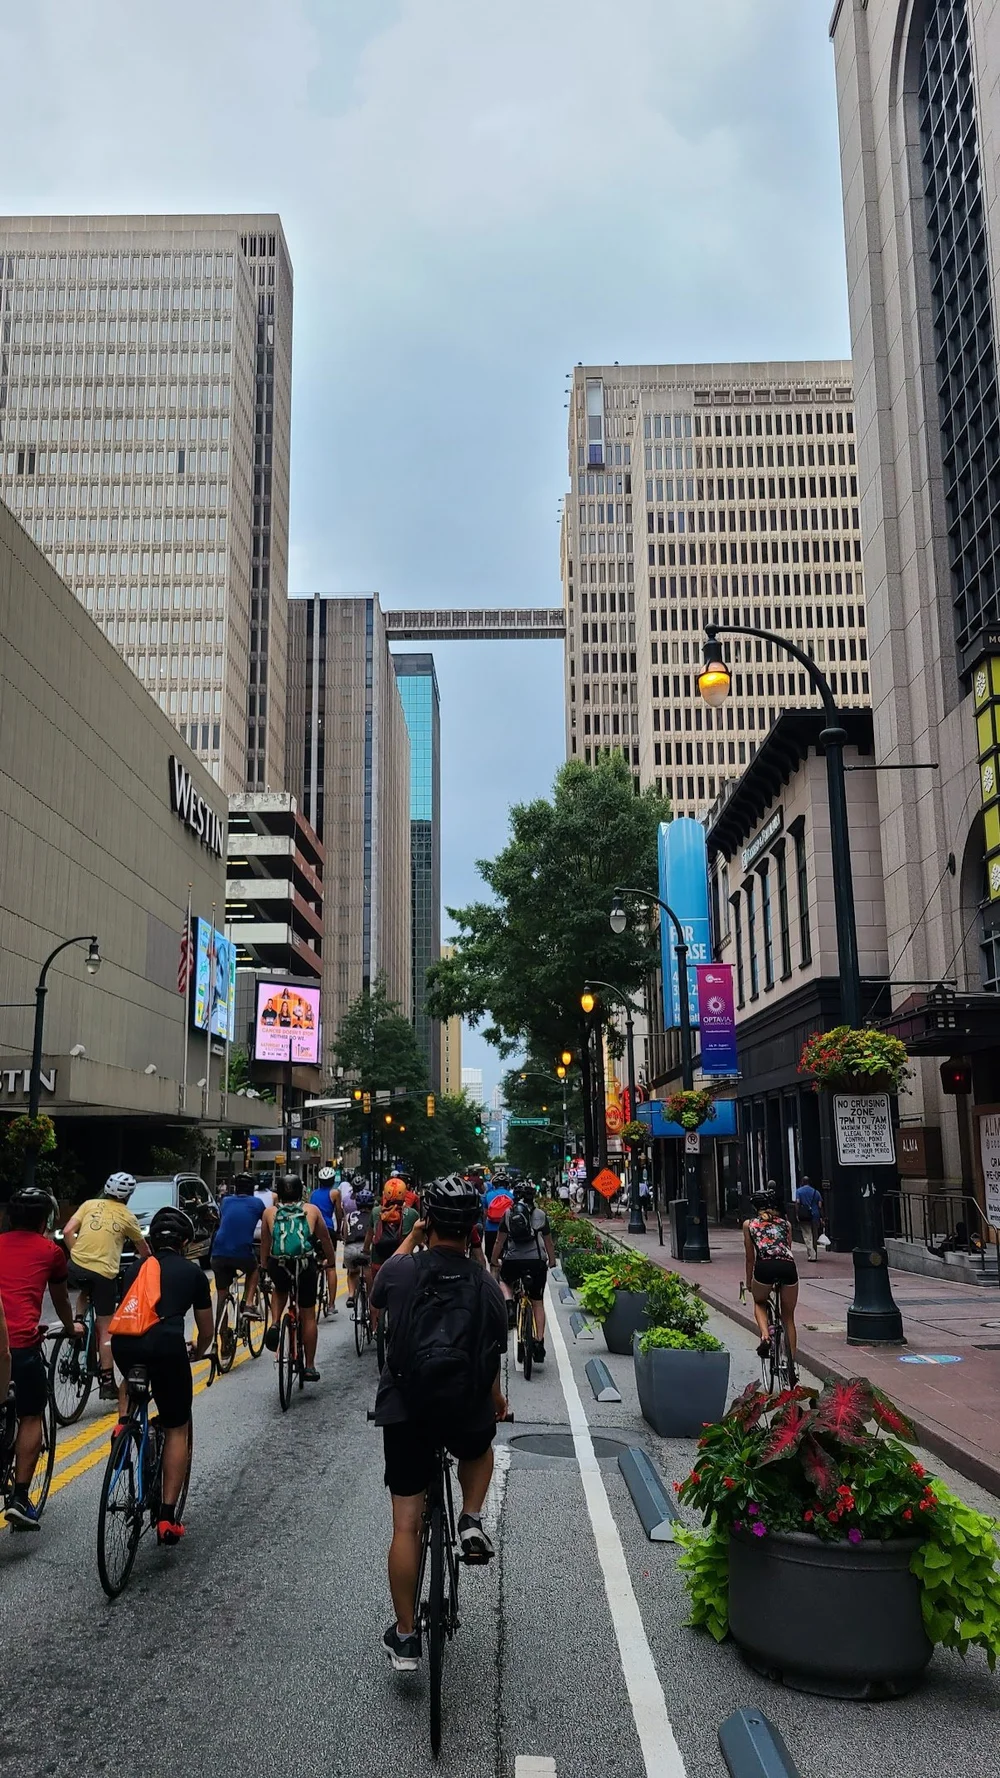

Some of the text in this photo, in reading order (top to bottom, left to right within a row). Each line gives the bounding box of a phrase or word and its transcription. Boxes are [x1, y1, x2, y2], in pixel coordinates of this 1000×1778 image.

[172, 756, 224, 859] WESTIN
[670, 943, 707, 960] LASE
[0, 1069, 55, 1092] TIN
[838, 1100, 885, 1108] NO CRUISING
[839, 1115, 887, 1125] 7PM TO 7AM
[902, 1139, 919, 1151] ALMA
